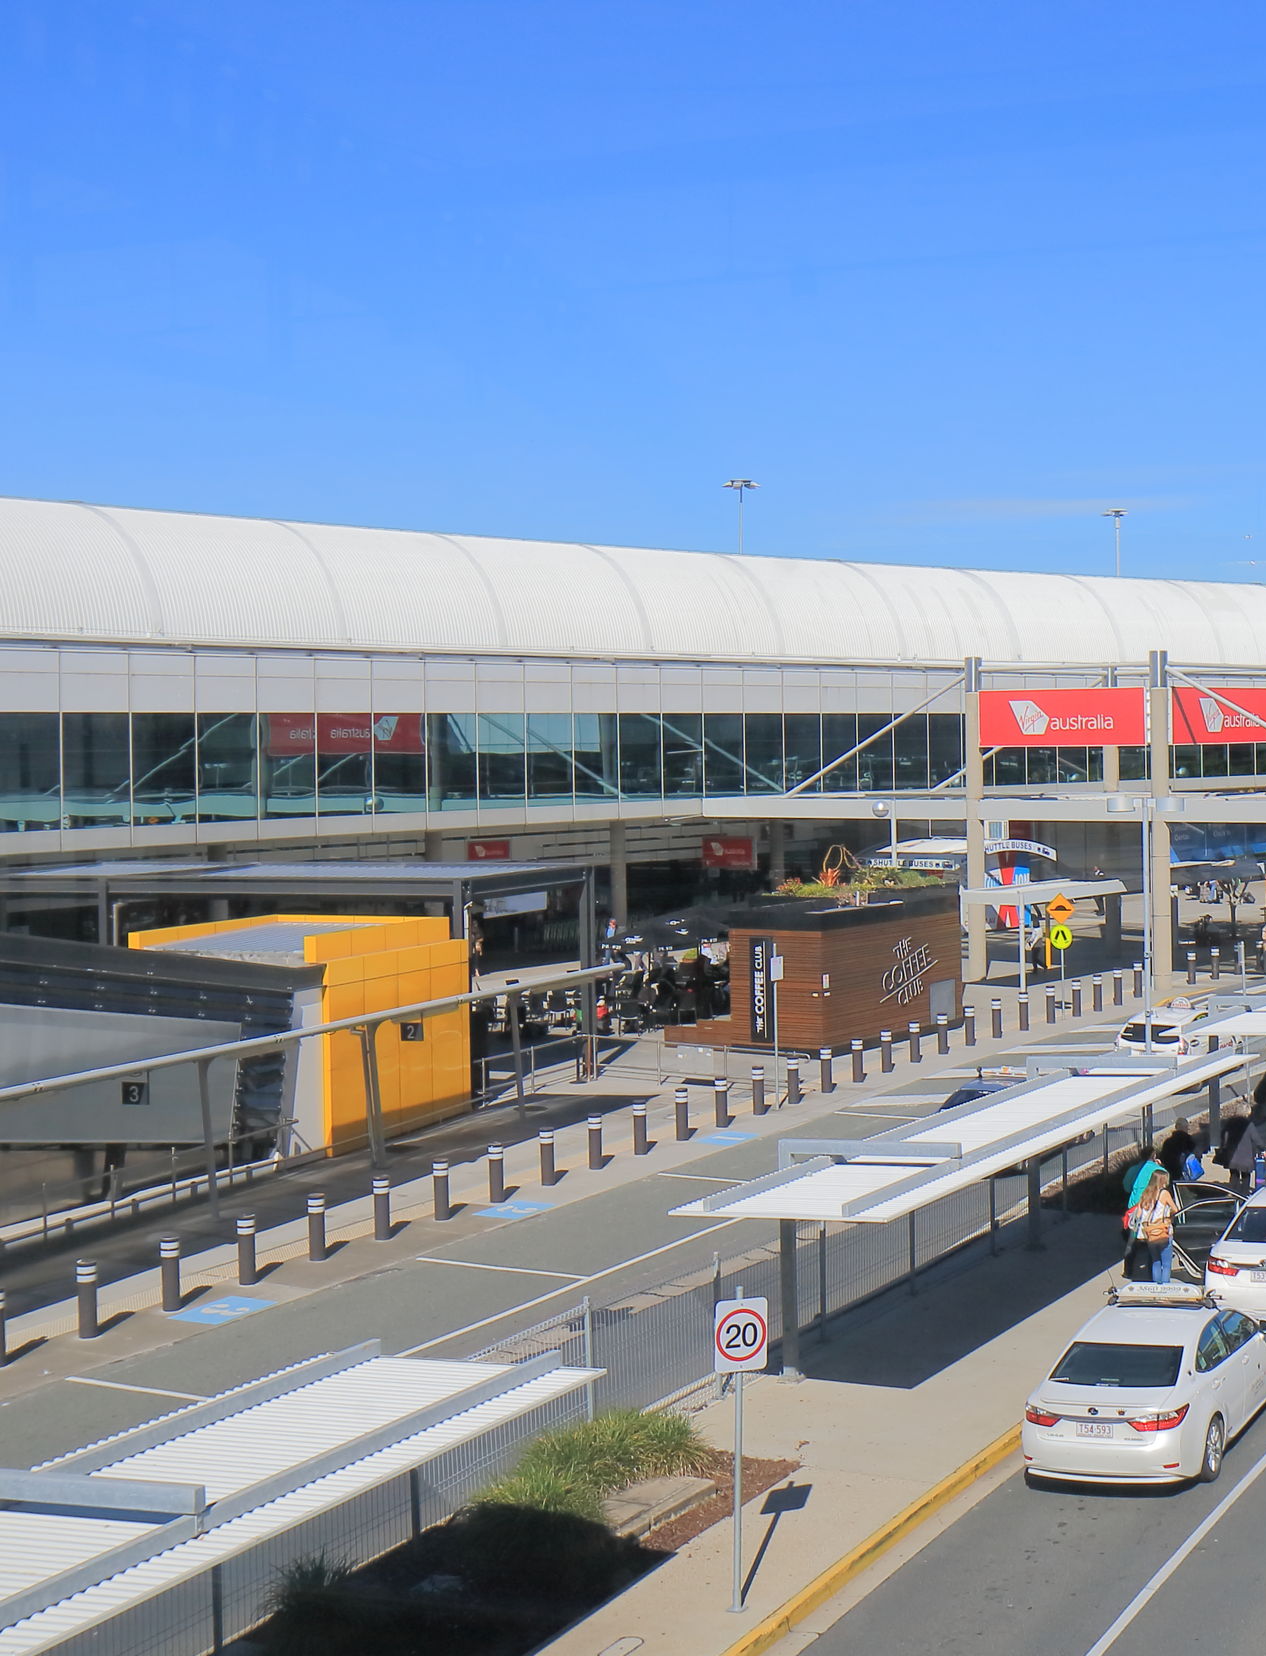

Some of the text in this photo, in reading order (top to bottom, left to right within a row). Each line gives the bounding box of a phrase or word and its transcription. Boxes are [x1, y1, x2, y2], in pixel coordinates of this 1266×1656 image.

[1050, 714, 1114, 730] australia
[985, 841, 1033, 853] HUTTLE BUSES
[873, 859, 934, 868] SHUTLE BUSES
[893, 936, 913, 960] THE
[882, 943, 933, 992] COFFEE
[754, 945, 765, 1033] THE COFFEE CLUB
[897, 978, 924, 1007] CLUB
[407, 1024, 415, 1040] 2
[129, 1085, 140, 1103] 3
[725, 1322, 758, 1349] 20
